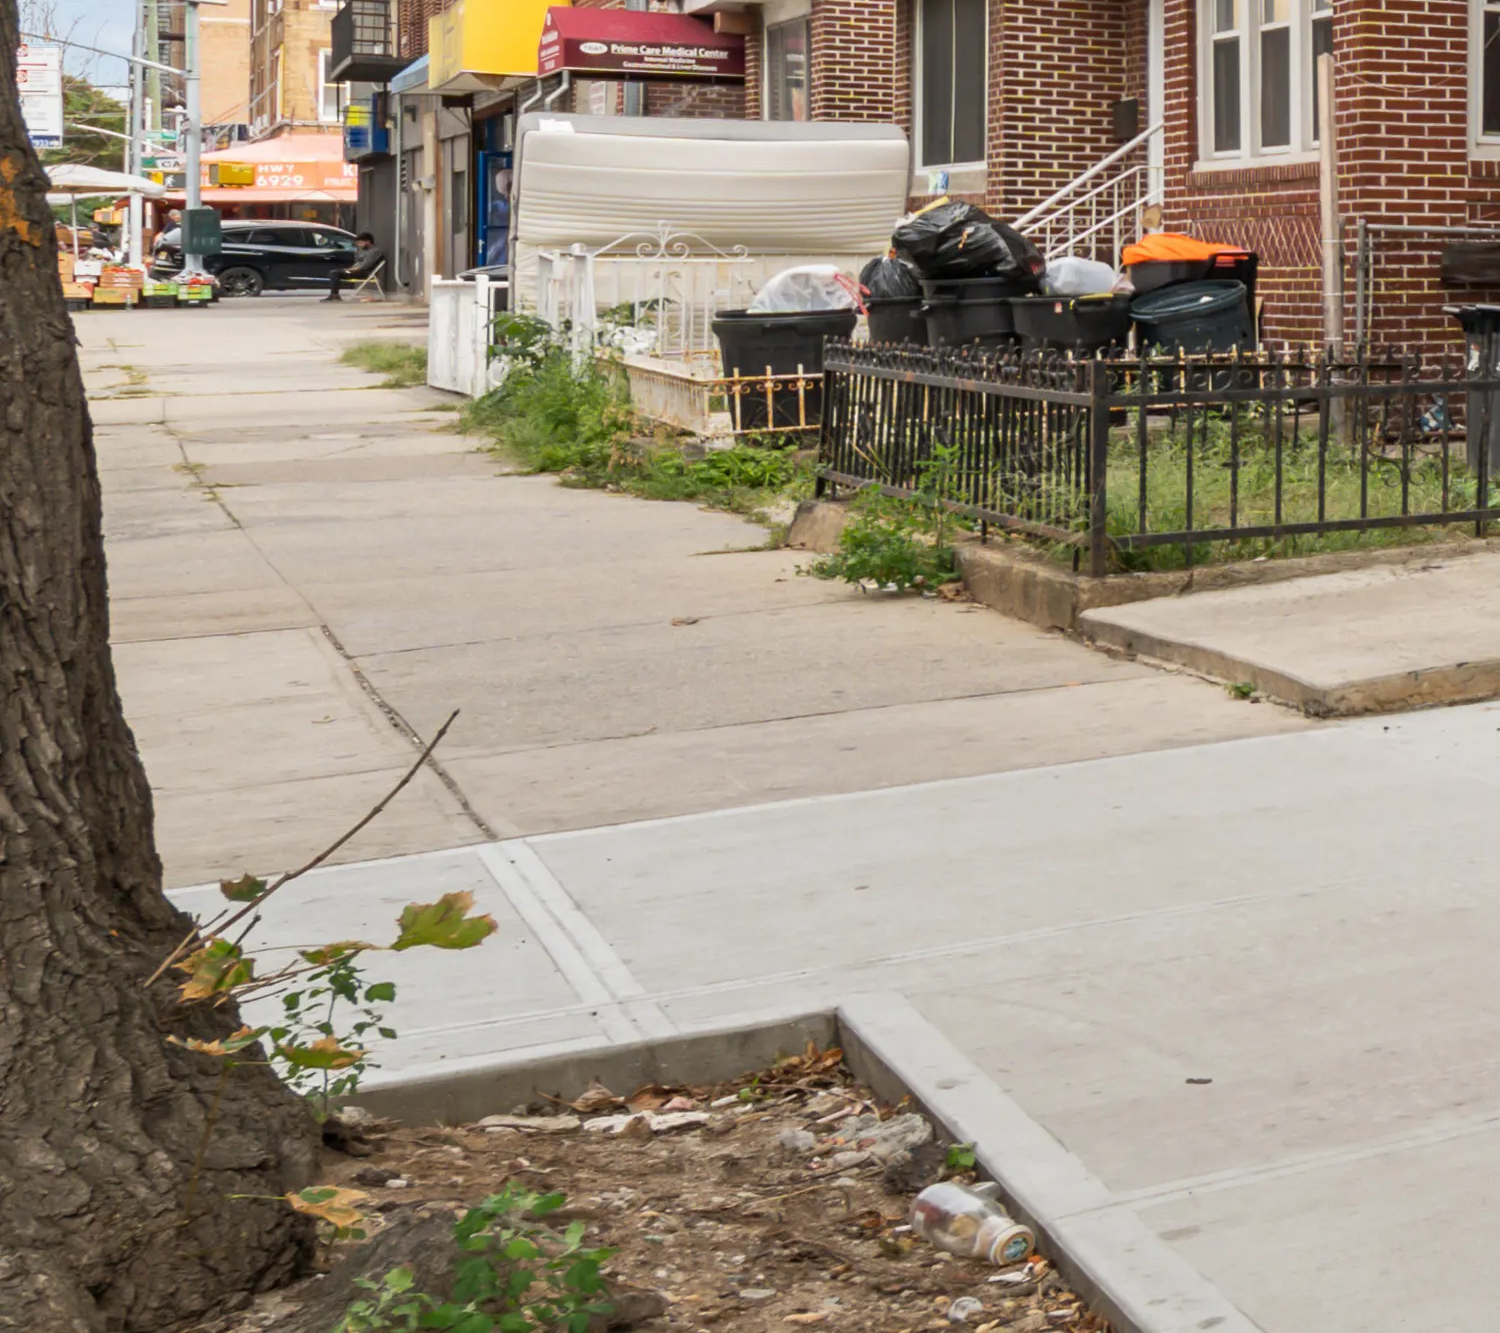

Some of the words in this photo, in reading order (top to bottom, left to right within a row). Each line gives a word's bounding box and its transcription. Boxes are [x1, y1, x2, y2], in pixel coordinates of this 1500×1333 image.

[611, 44, 638, 54] Prime
[640, 45, 661, 55] Care
[662, 46, 697, 56] Medical
[699, 48, 729, 59] Center
[257, 164, 295, 173] HWY
[256, 174, 304, 187] 6929
